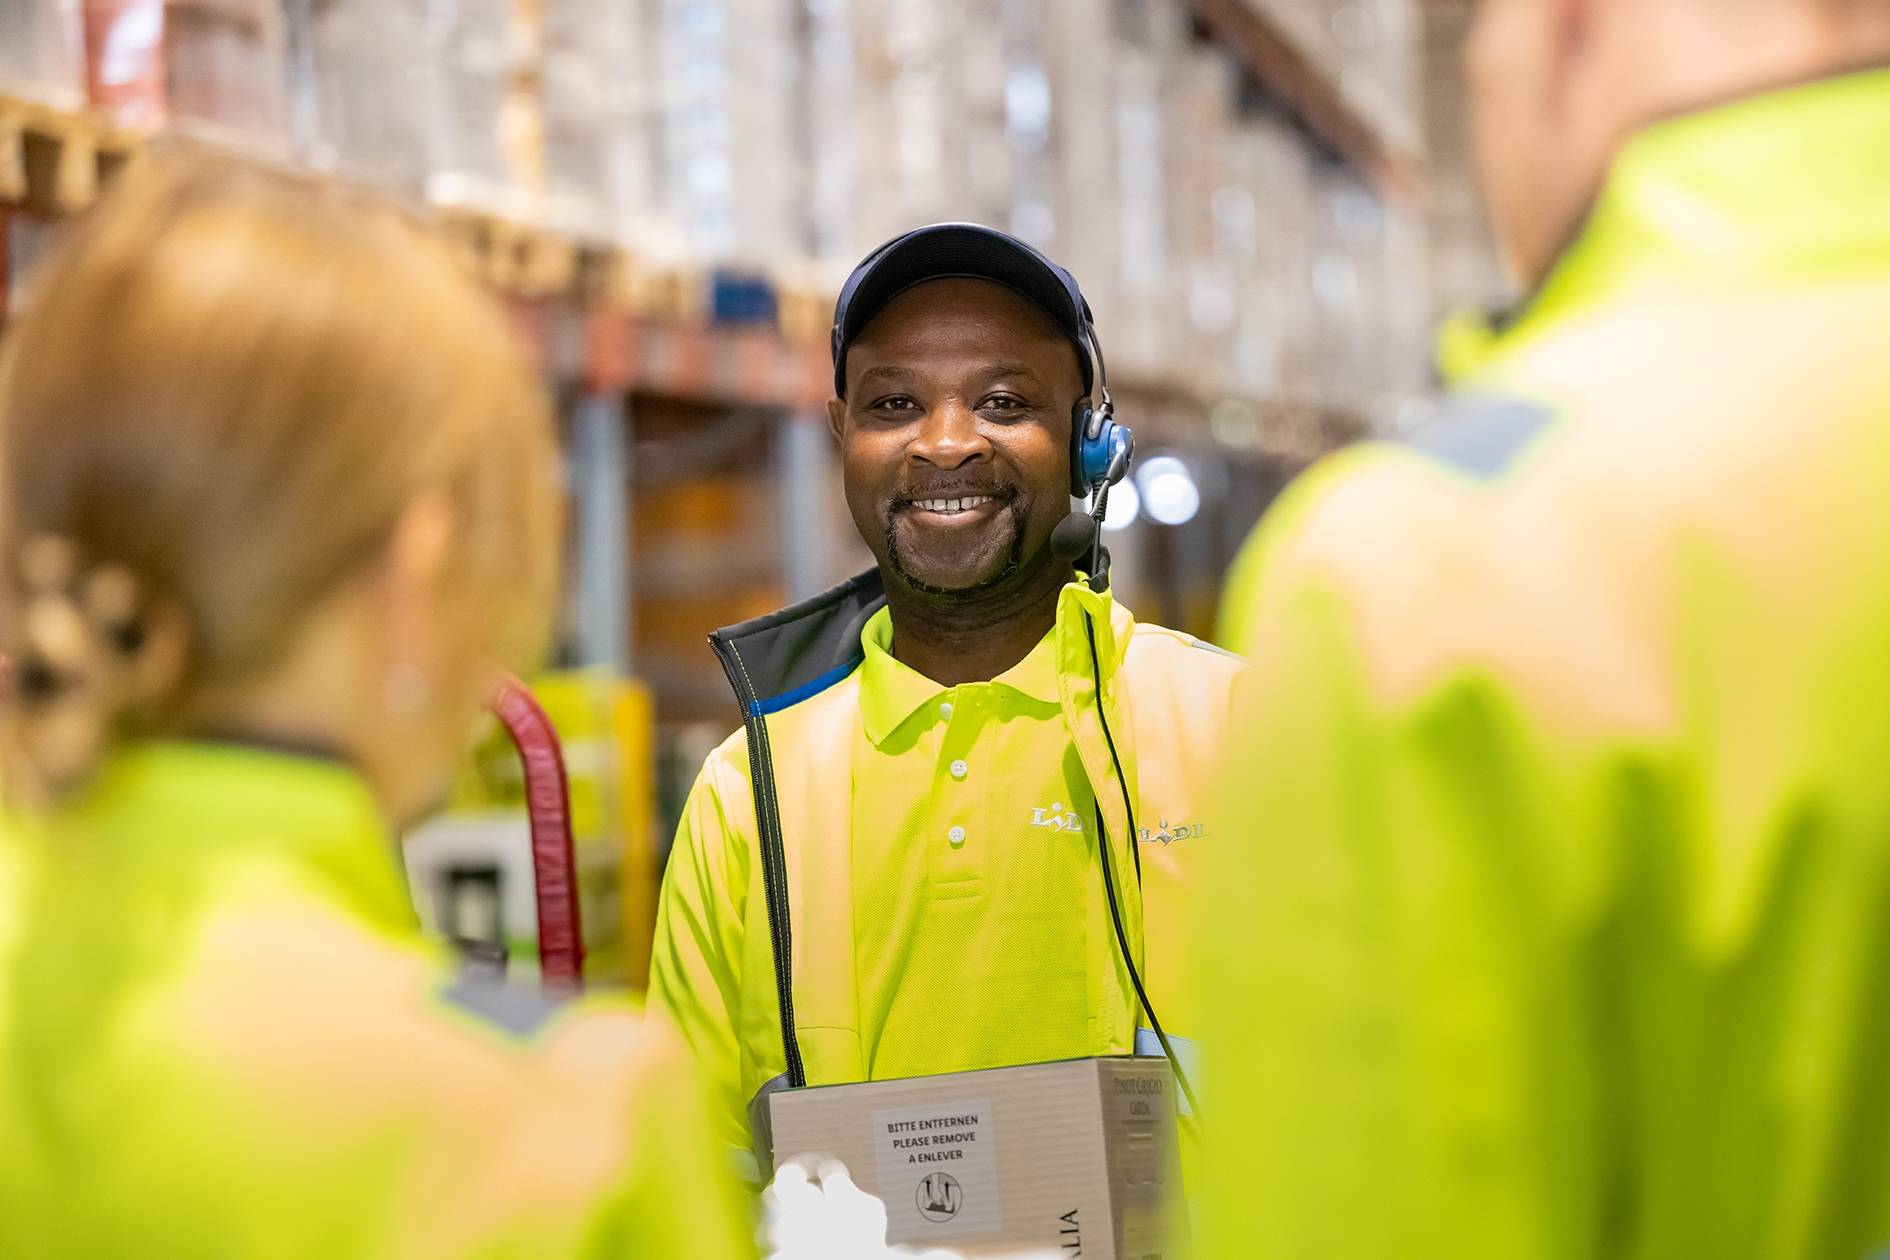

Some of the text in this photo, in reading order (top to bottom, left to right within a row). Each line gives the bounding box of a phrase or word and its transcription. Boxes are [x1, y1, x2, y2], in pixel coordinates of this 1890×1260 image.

[888, 1115, 978, 1133] BITTE ENTFERNEN
[893, 1132, 975, 1149] PLEASE REMOVE
[908, 1150, 963, 1163] A ENLEVER
